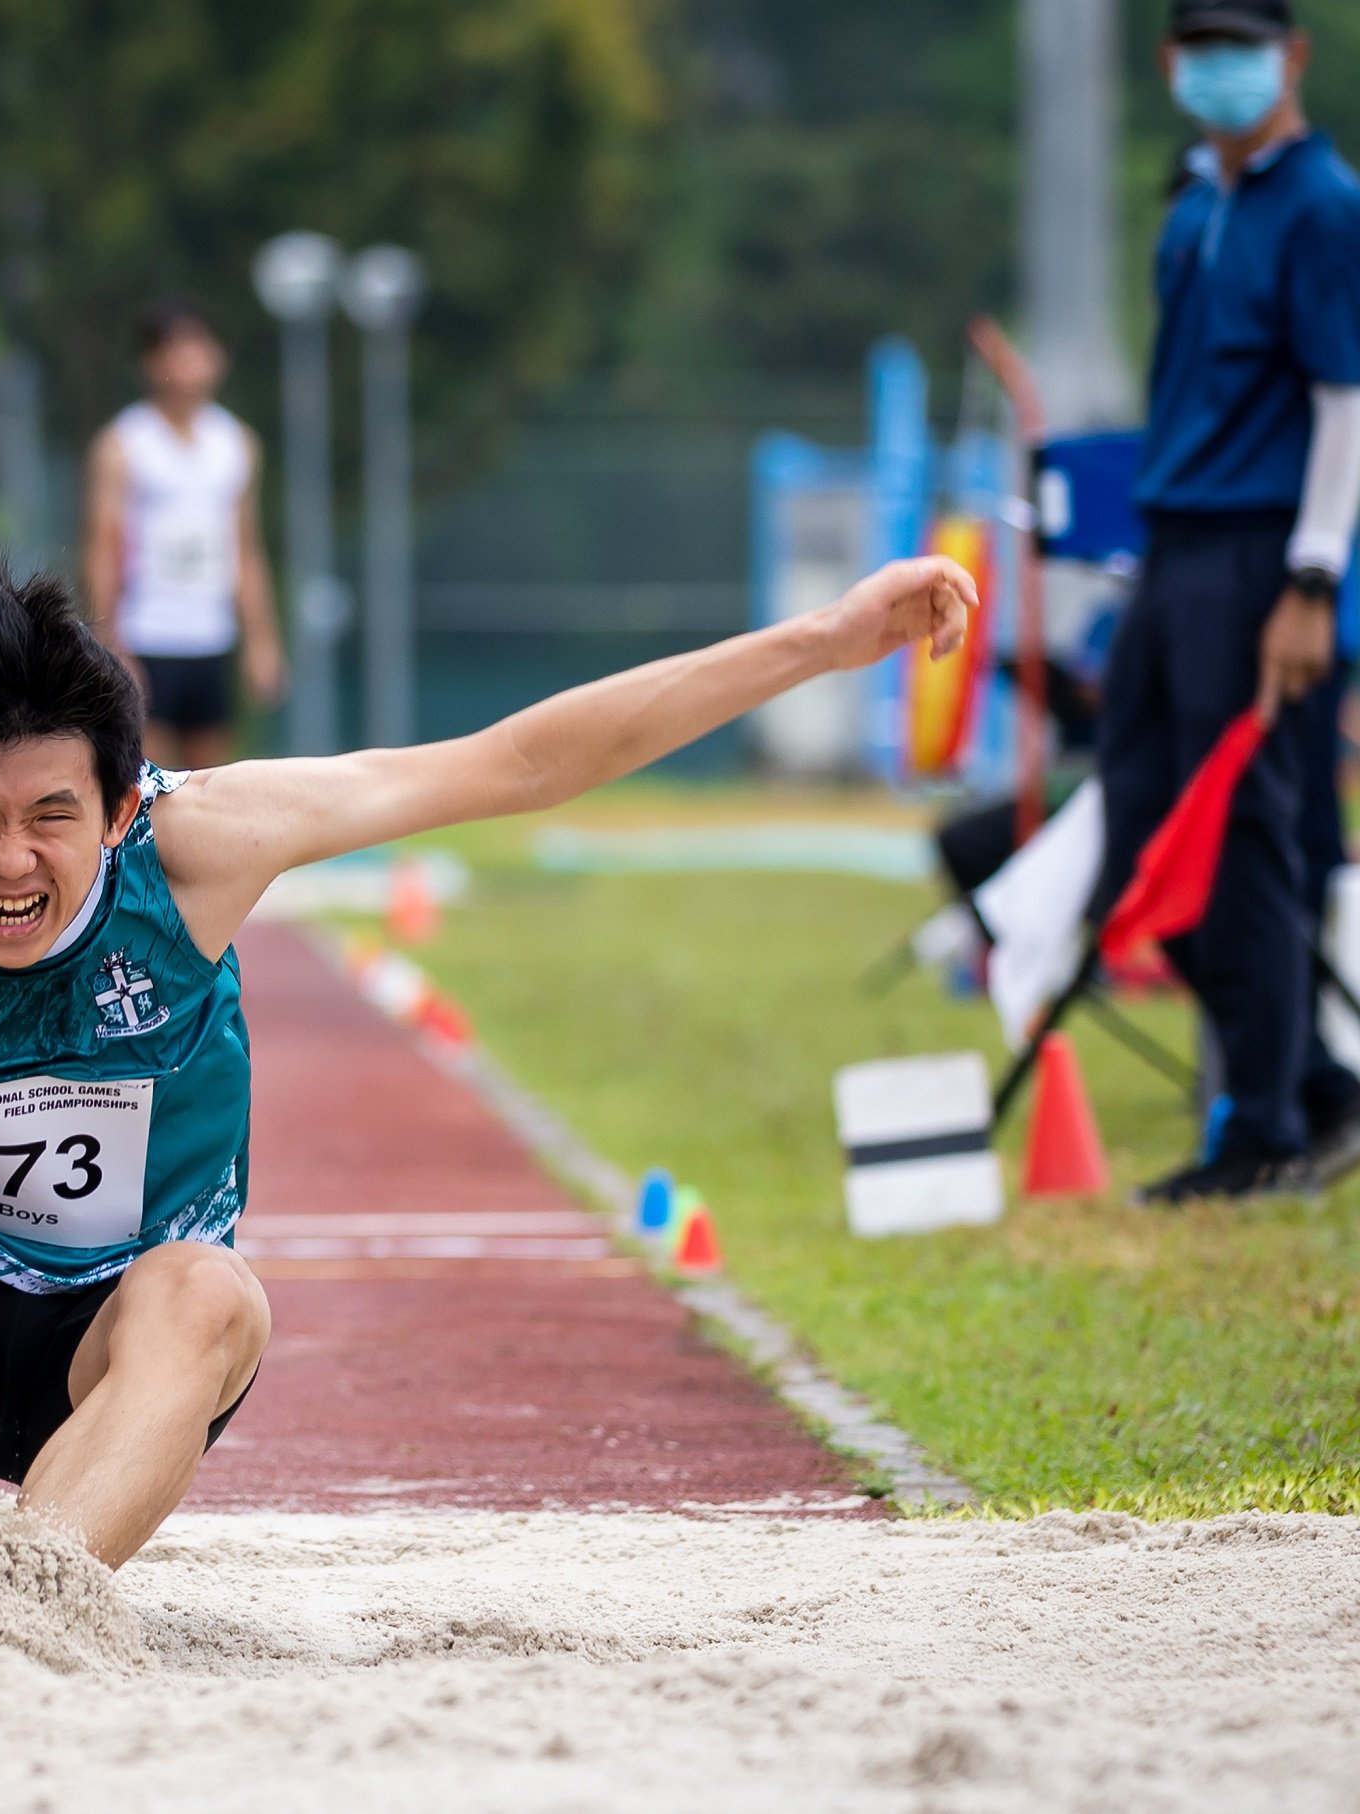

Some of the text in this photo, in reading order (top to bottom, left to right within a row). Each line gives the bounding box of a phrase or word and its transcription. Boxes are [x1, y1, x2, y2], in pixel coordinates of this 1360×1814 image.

[28, 1085, 74, 1099] SCHOOL
[78, 1085, 121, 1097] GAMES
[4, 1103, 35, 1118] FIELD
[39, 1098, 139, 1111] CHAMPIONSHIPS
